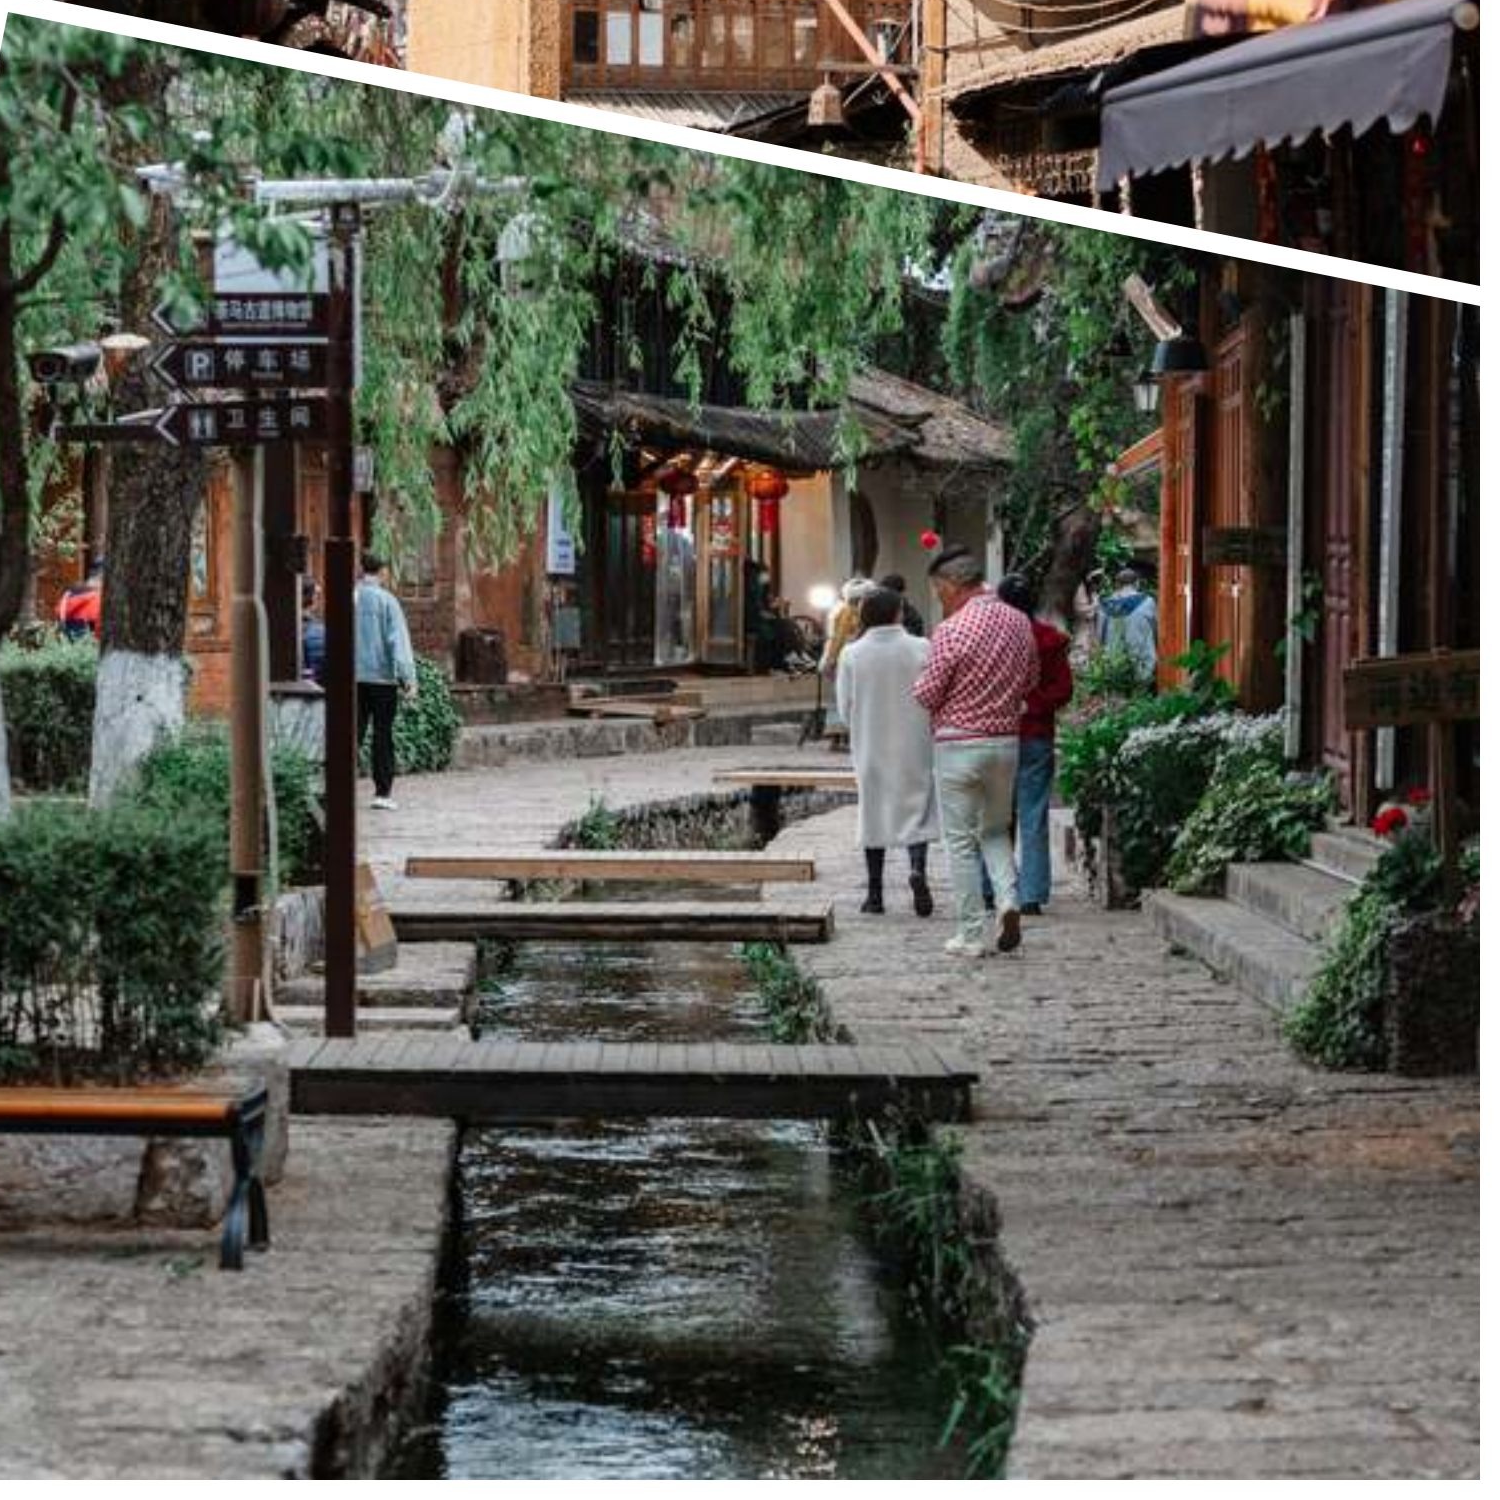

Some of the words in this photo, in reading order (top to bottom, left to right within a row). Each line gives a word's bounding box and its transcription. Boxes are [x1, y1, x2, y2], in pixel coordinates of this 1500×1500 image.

[224, 349, 310, 373] 停车场
[226, 406, 310, 429] 卫生间
